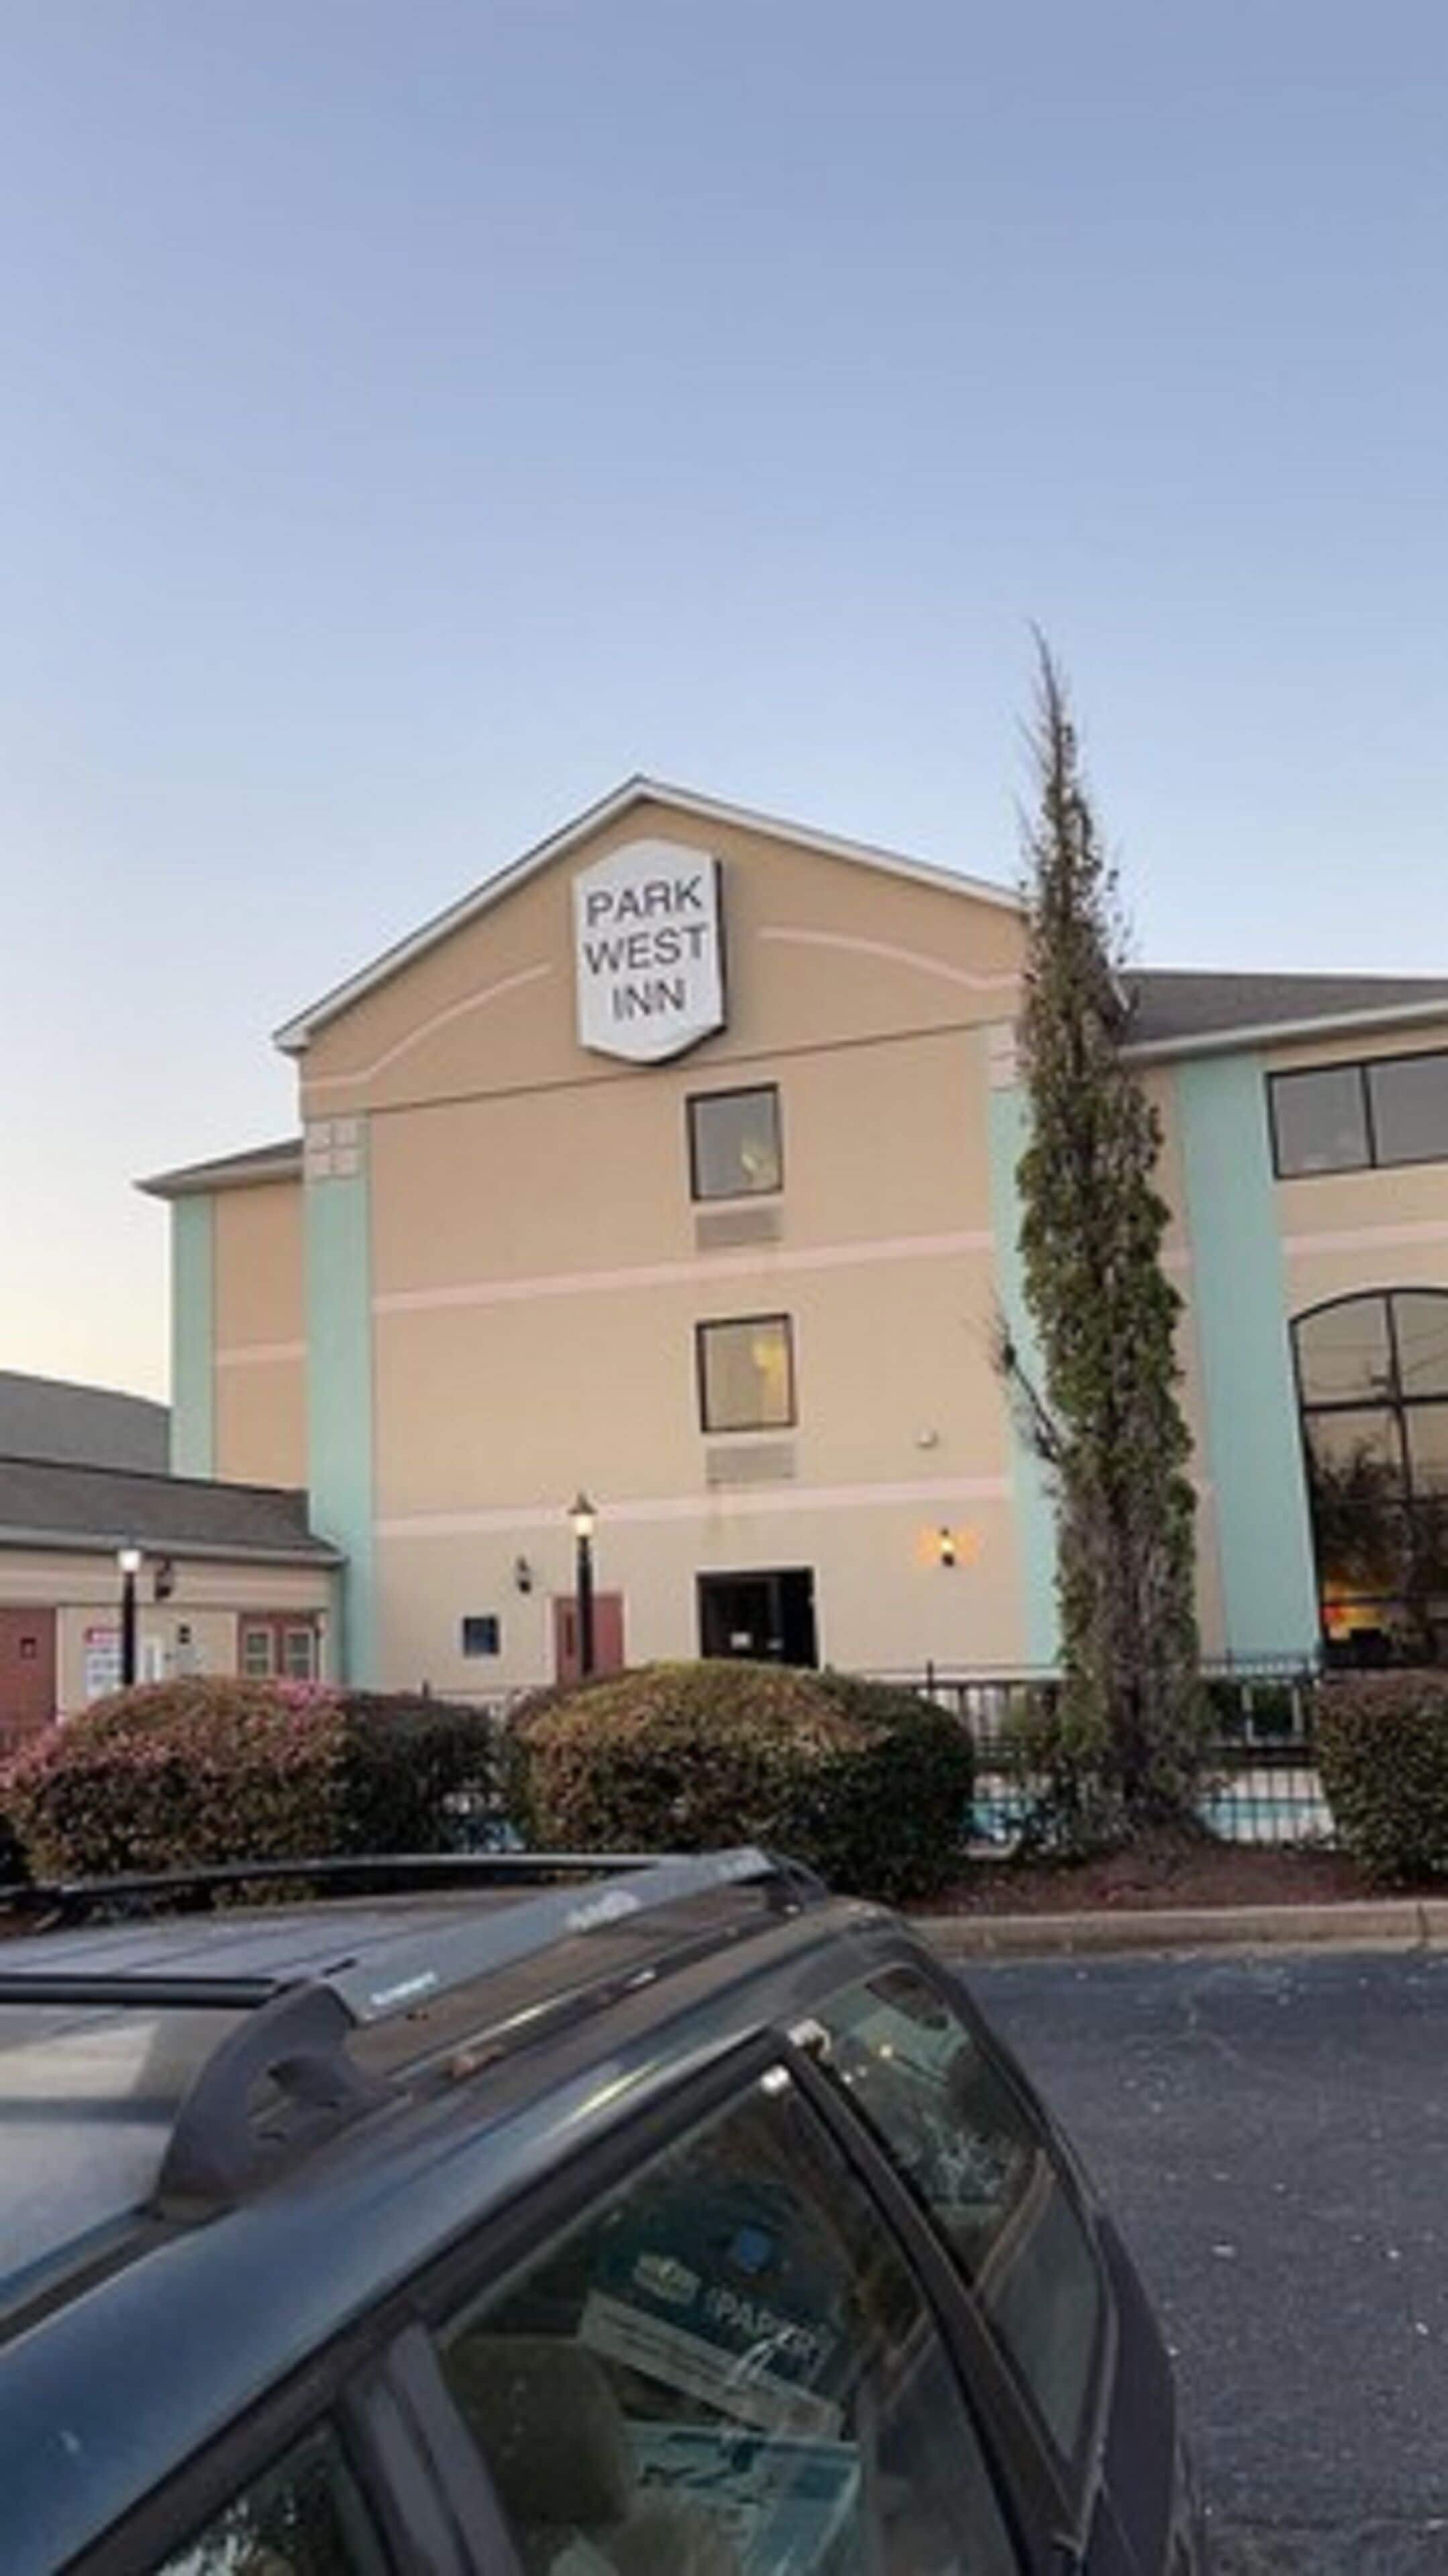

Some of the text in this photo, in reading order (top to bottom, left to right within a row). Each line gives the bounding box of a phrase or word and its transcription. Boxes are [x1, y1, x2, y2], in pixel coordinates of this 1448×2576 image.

[586, 875, 703, 928] PARK
[583, 922, 708, 975] WEST
[611, 978, 686, 1021] INN
